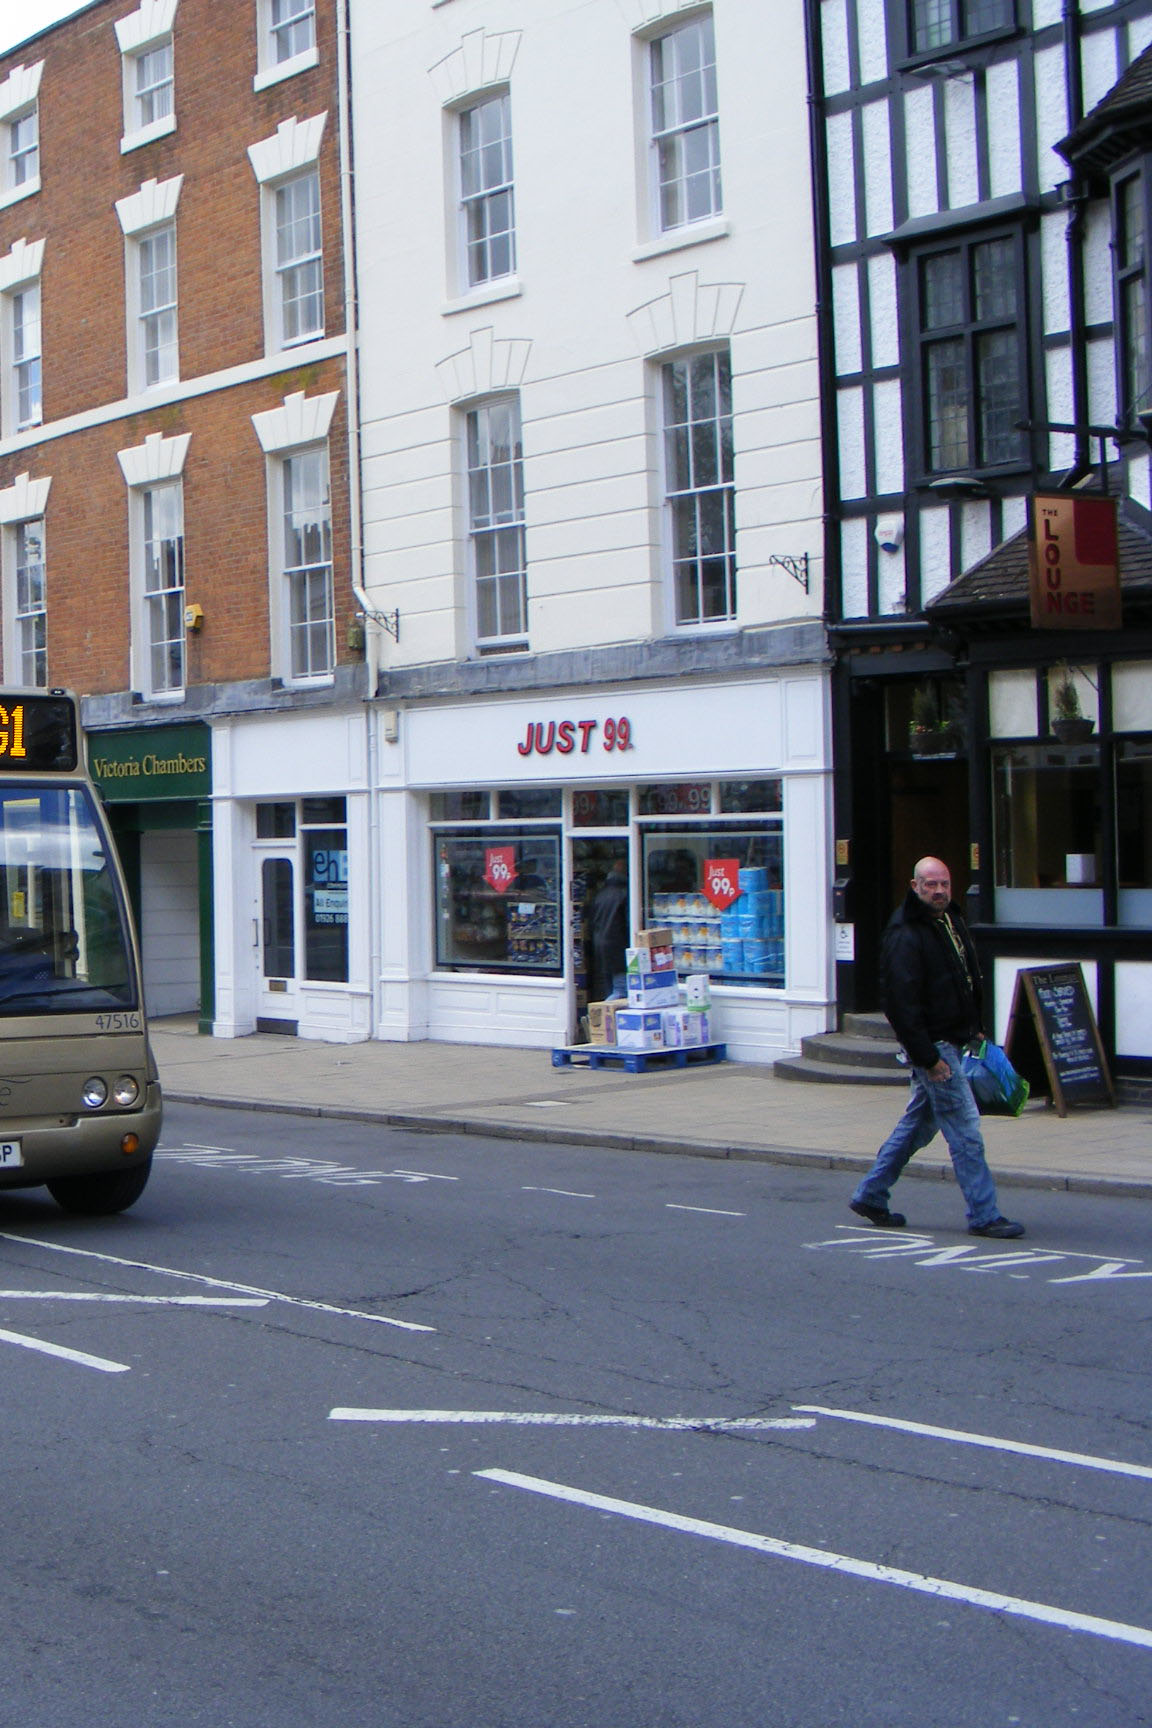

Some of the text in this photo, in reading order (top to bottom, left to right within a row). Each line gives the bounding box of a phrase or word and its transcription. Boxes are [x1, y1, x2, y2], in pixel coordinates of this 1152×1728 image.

[1041, 508, 1058, 517] THE
[517, 719, 597, 755] JUST
[93, 753, 206, 778] Victoria Chambers
[707, 864, 725, 880] Just
[712, 877, 736, 897] 99p
[95, 1014, 140, 1030] 47516
